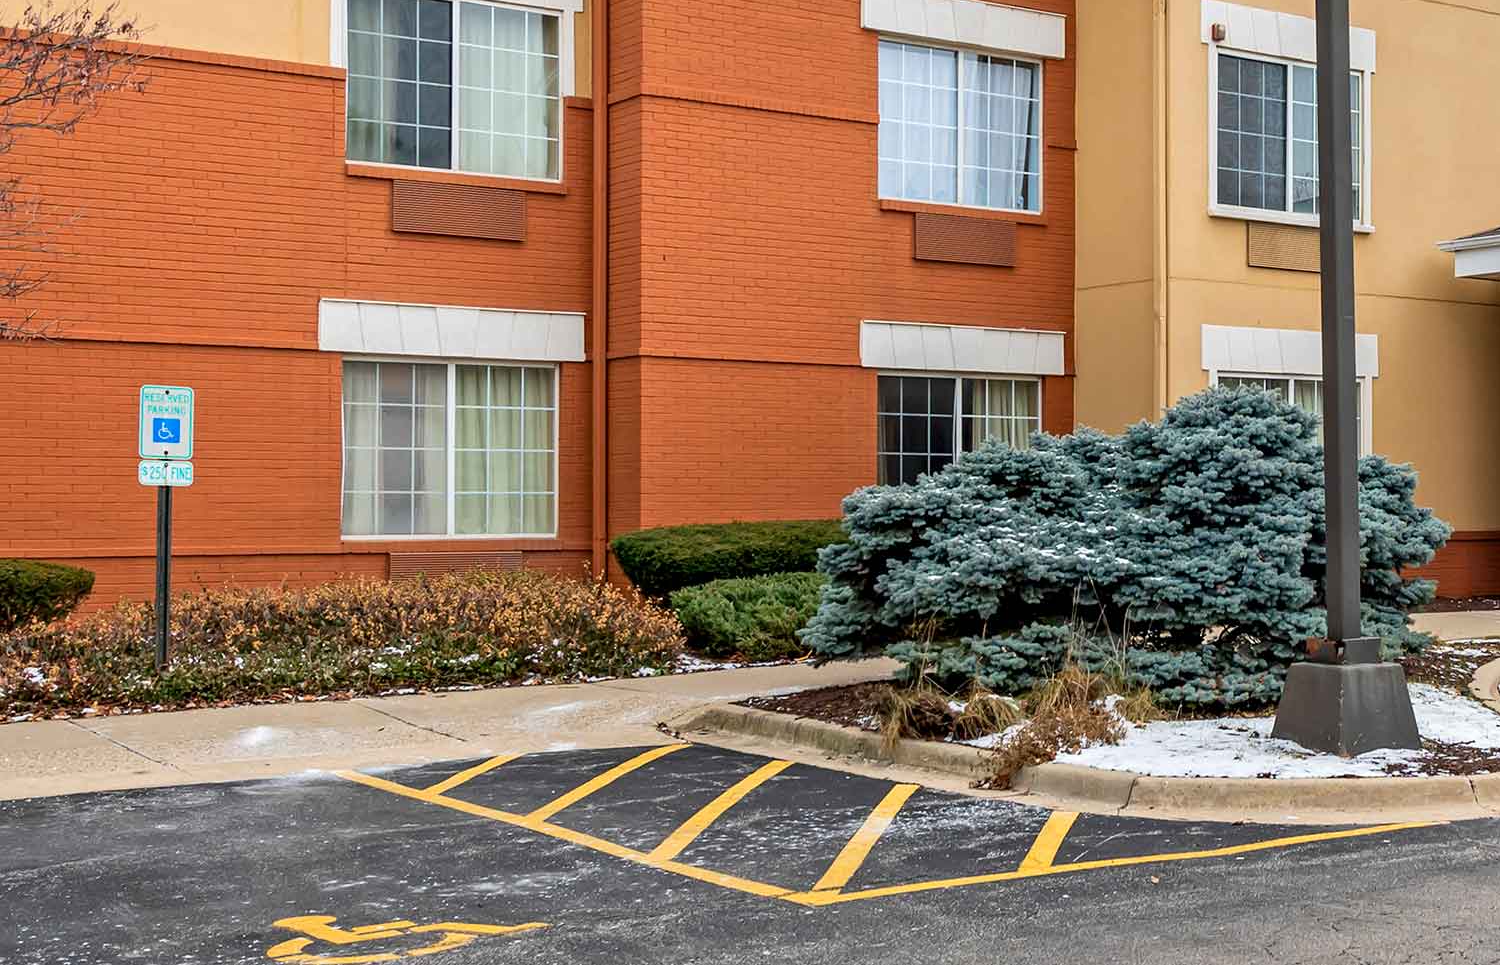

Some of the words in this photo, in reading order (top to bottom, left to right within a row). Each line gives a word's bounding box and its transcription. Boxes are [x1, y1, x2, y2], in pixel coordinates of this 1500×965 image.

[145, 393, 189, 403] RESERVED
[148, 405, 186, 414] PARKING
[171, 467, 192, 481] FINE
